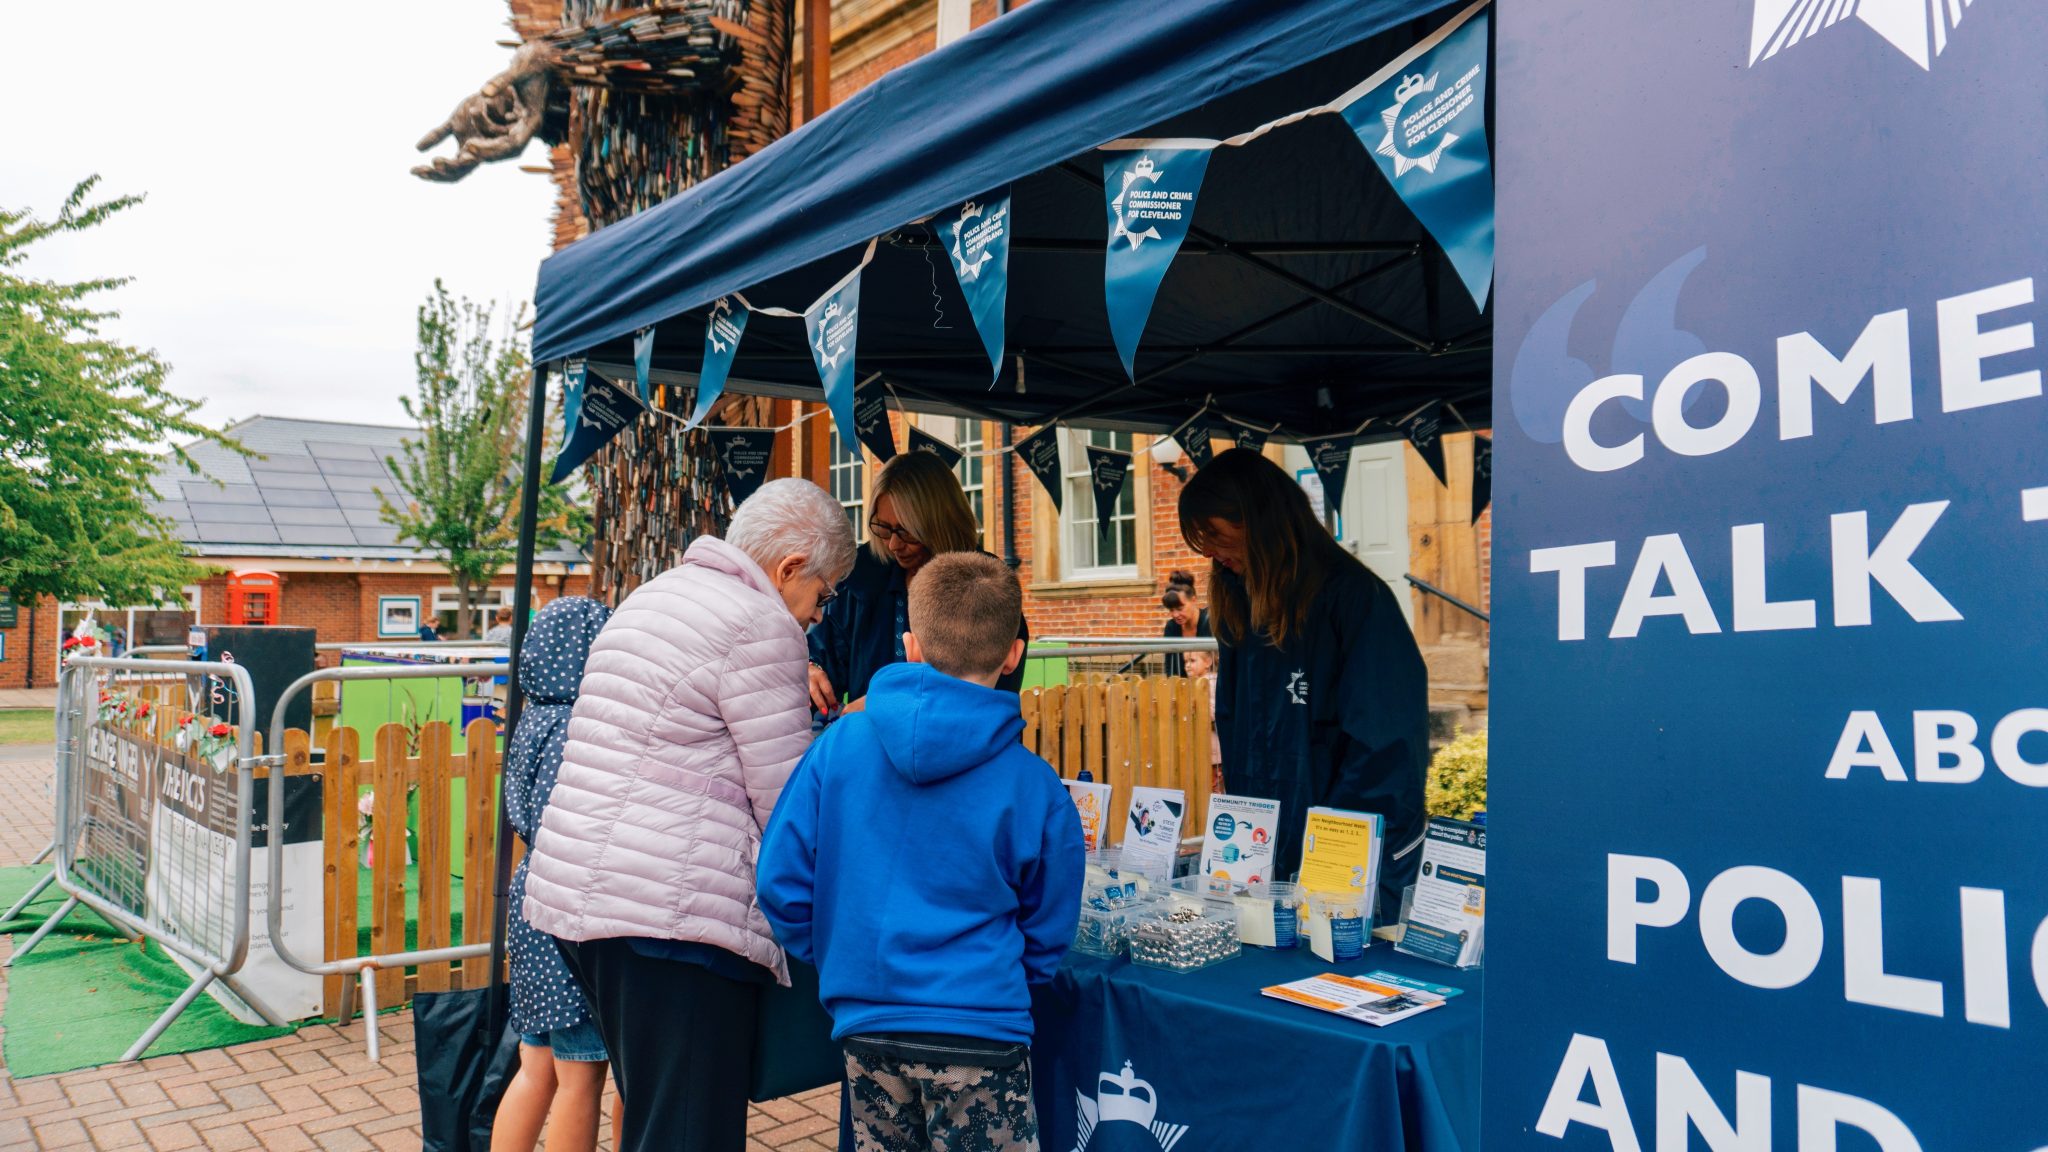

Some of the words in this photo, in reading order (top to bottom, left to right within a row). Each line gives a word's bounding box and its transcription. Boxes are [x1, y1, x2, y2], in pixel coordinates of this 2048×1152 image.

[1403, 102, 1433, 128] POLICE
[1435, 87, 1454, 106] AND
[1455, 64, 1480, 90] CRIME
[1405, 84, 1472, 137] COMMISSIONER
[1407, 131, 1426, 148] FOR
[1428, 94, 1474, 134] CLEVELAND
[1129, 201, 1181, 210] COMMISSIONER
[1130, 191, 1151, 199] POLICE
[1152, 191, 1167, 199] AND
[1169, 192, 1193, 200] CRIME
[1128, 210, 1139, 218] FOR
[1140, 211, 1181, 220] CLEVELAND
[964, 225, 980, 240] POLICE
[980, 218, 991, 229] AND
[965, 220, 1002, 247] COMMISSIONER
[967, 245, 976, 256] FOR
[976, 228, 1004, 248] CLEVELAND
[1563, 278, 2043, 472] COME
[1530, 500, 1964, 641] TALK
[1824, 708, 2048, 787] ABO
[1213, 797, 1247, 806] COMMUNITY
[1249, 801, 1275, 809] TRIGGER
[1322, 818, 1353, 827] Neighbourhood
[1308, 833, 1315, 853] 1
[1350, 864, 1365, 887] 2
[1608, 853, 2048, 1029] POLI
[1535, 1032, 1924, 1152] AND
